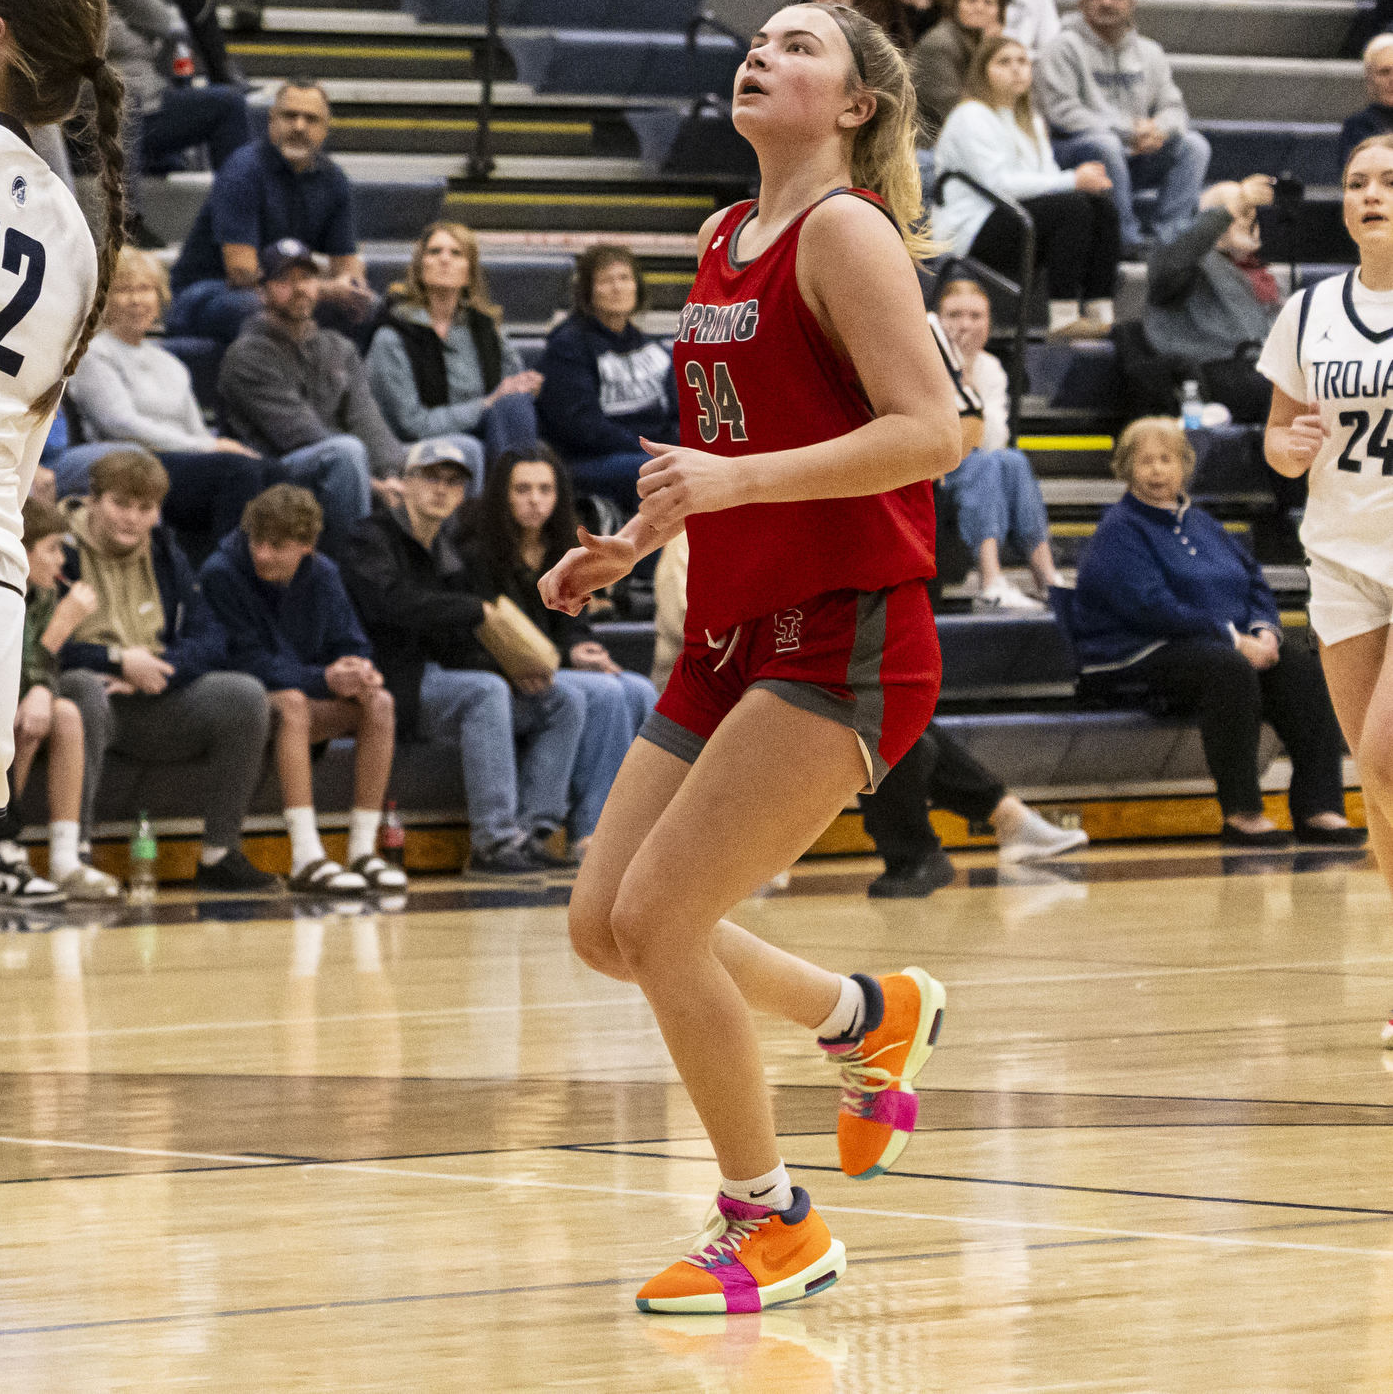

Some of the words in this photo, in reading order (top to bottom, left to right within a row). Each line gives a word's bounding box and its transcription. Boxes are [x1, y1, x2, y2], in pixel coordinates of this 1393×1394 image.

[675, 299, 759, 344] SPRING
[685, 360, 749, 444] 34
[1338, 409, 1393, 477] 24
